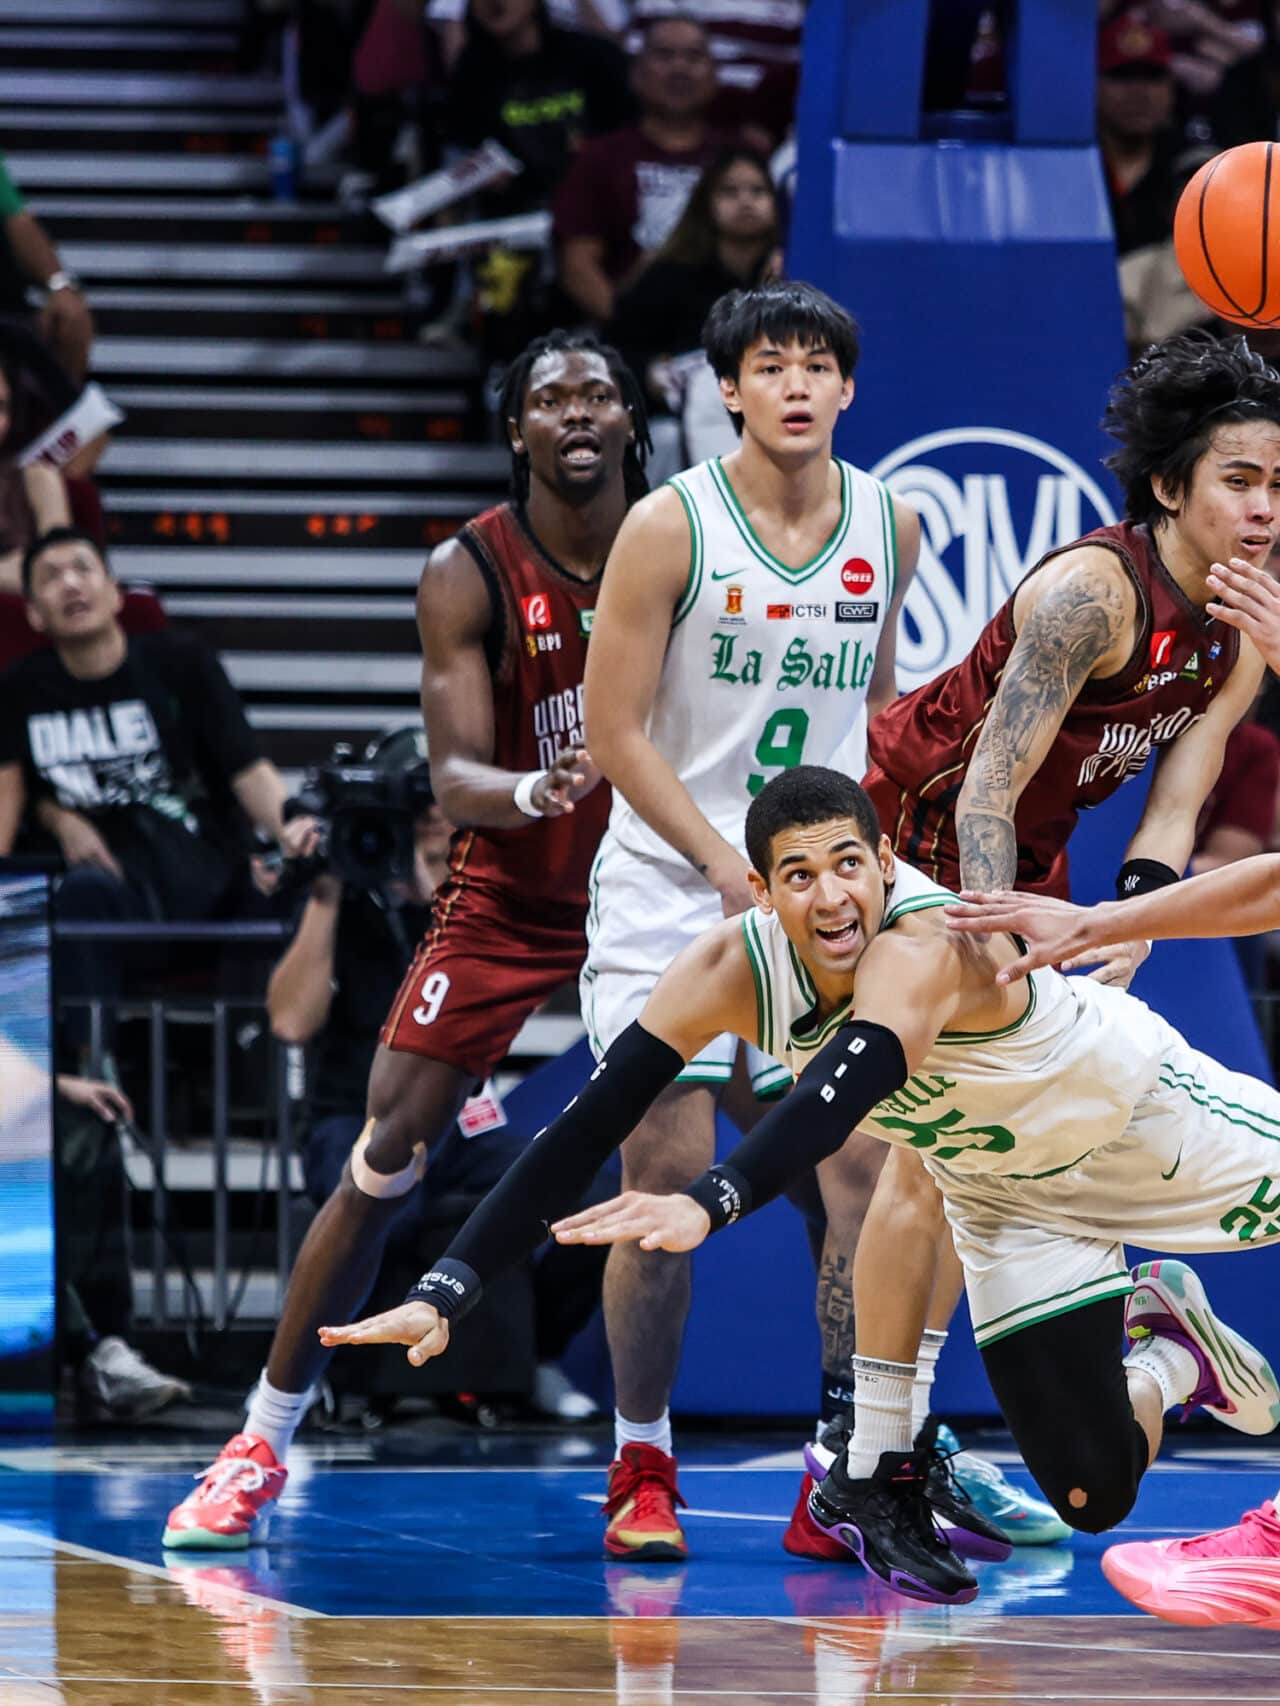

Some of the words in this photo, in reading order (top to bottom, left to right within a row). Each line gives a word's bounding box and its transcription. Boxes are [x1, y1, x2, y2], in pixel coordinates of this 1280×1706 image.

[791, 604, 827, 618] ICTSI
[709, 632, 763, 686] La
[776, 636, 874, 692] Salle
[412, 970, 451, 1026] 9
